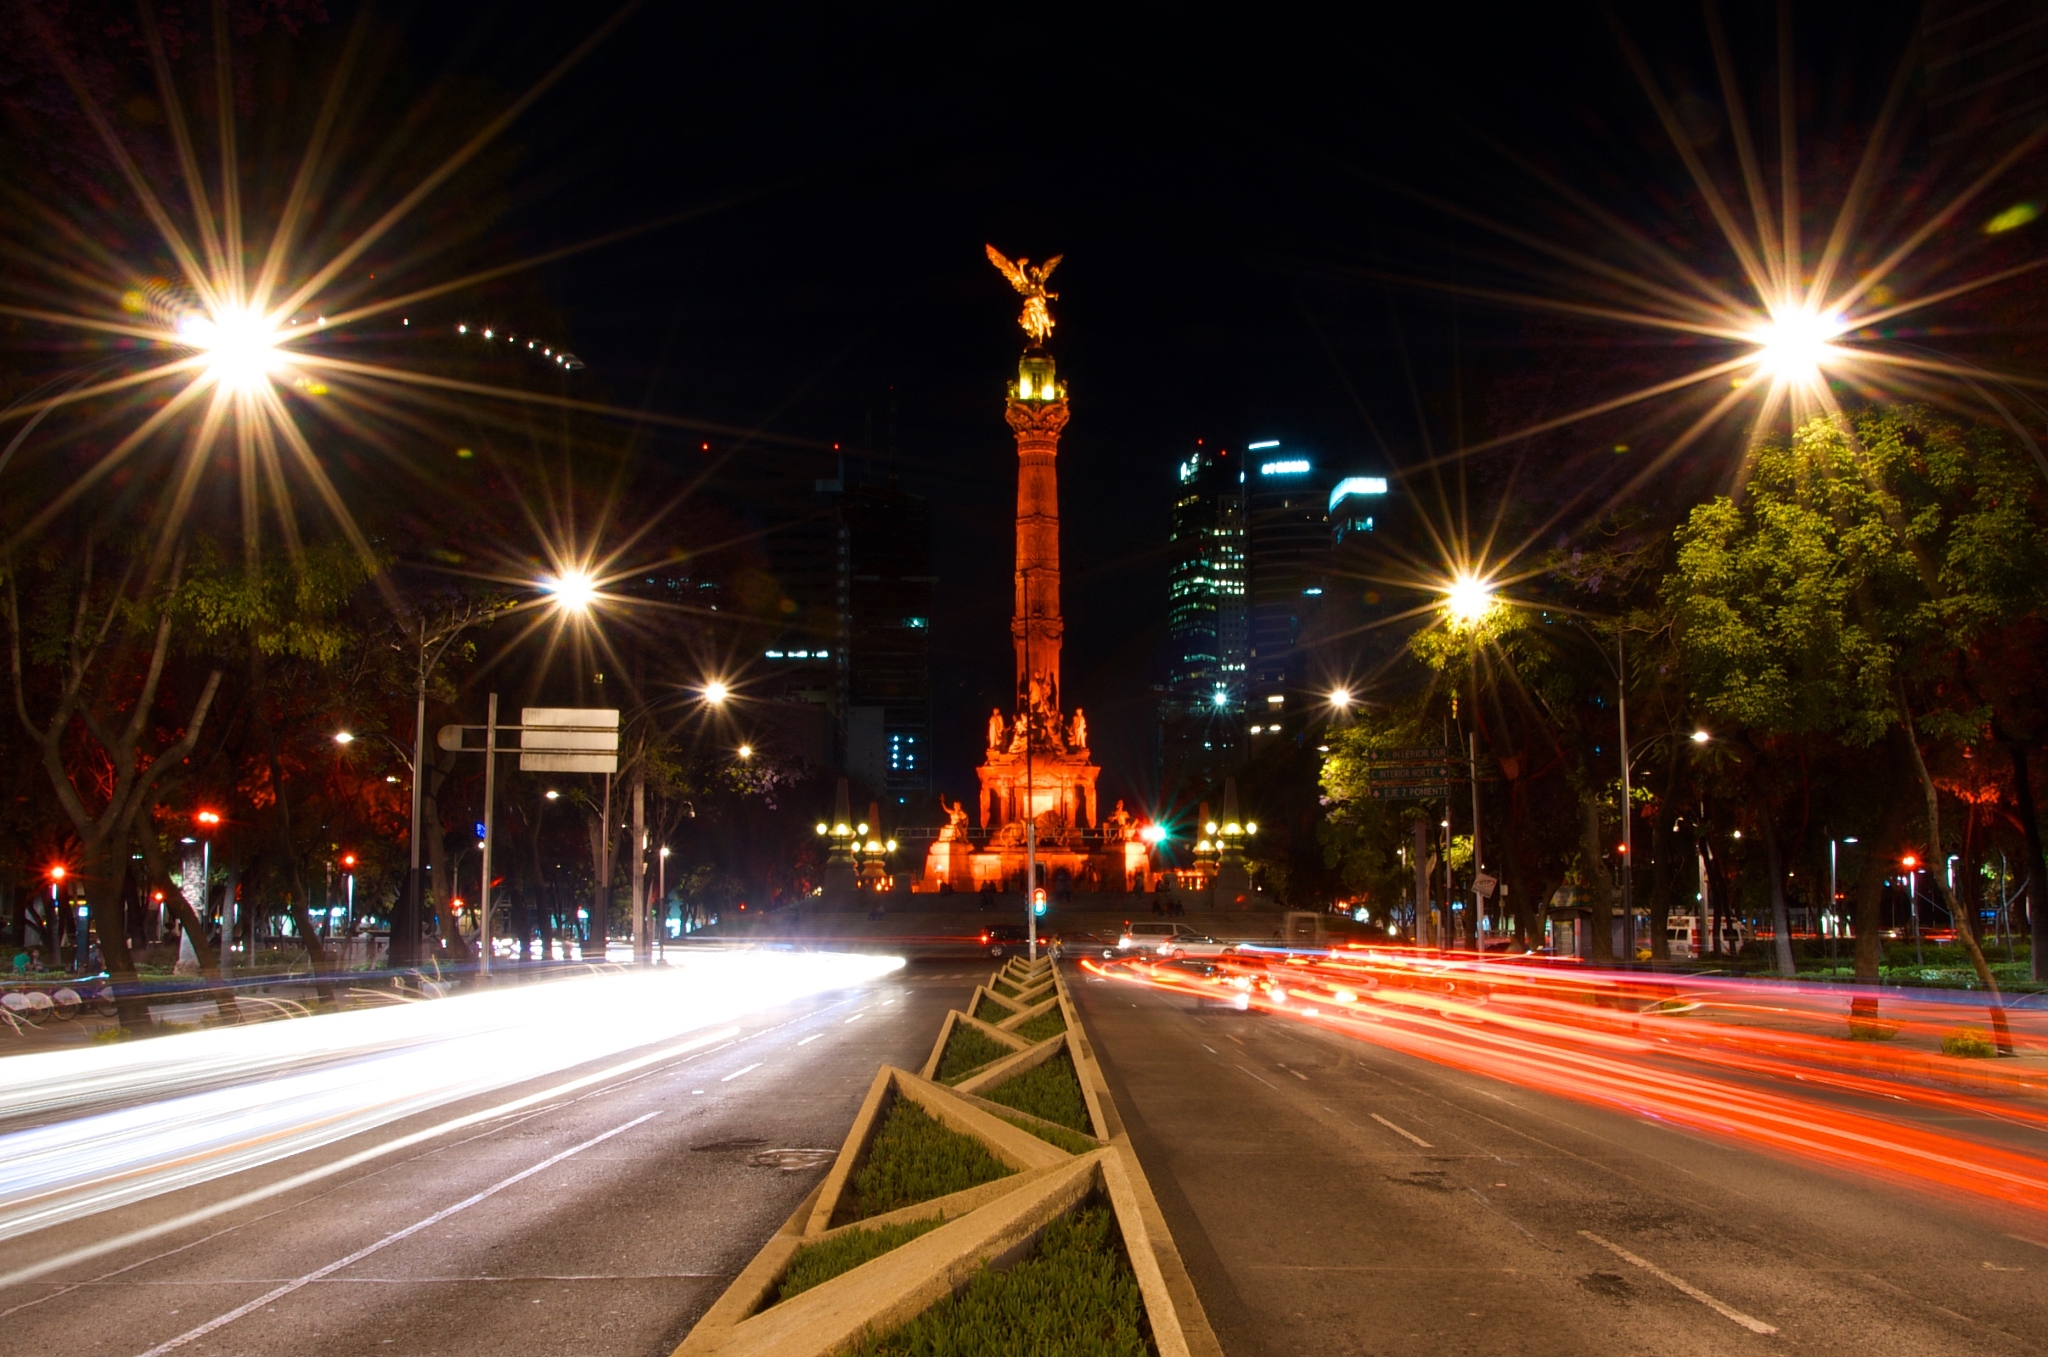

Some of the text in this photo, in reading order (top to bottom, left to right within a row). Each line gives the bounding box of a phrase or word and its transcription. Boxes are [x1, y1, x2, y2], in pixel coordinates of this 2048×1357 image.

[1431, 748, 1446, 757] SUR
[1379, 769, 1410, 778] INTERIOR
[1412, 768, 1435, 777] NORTE
[1384, 786, 1449, 798] EJE 2 PONIENTE
